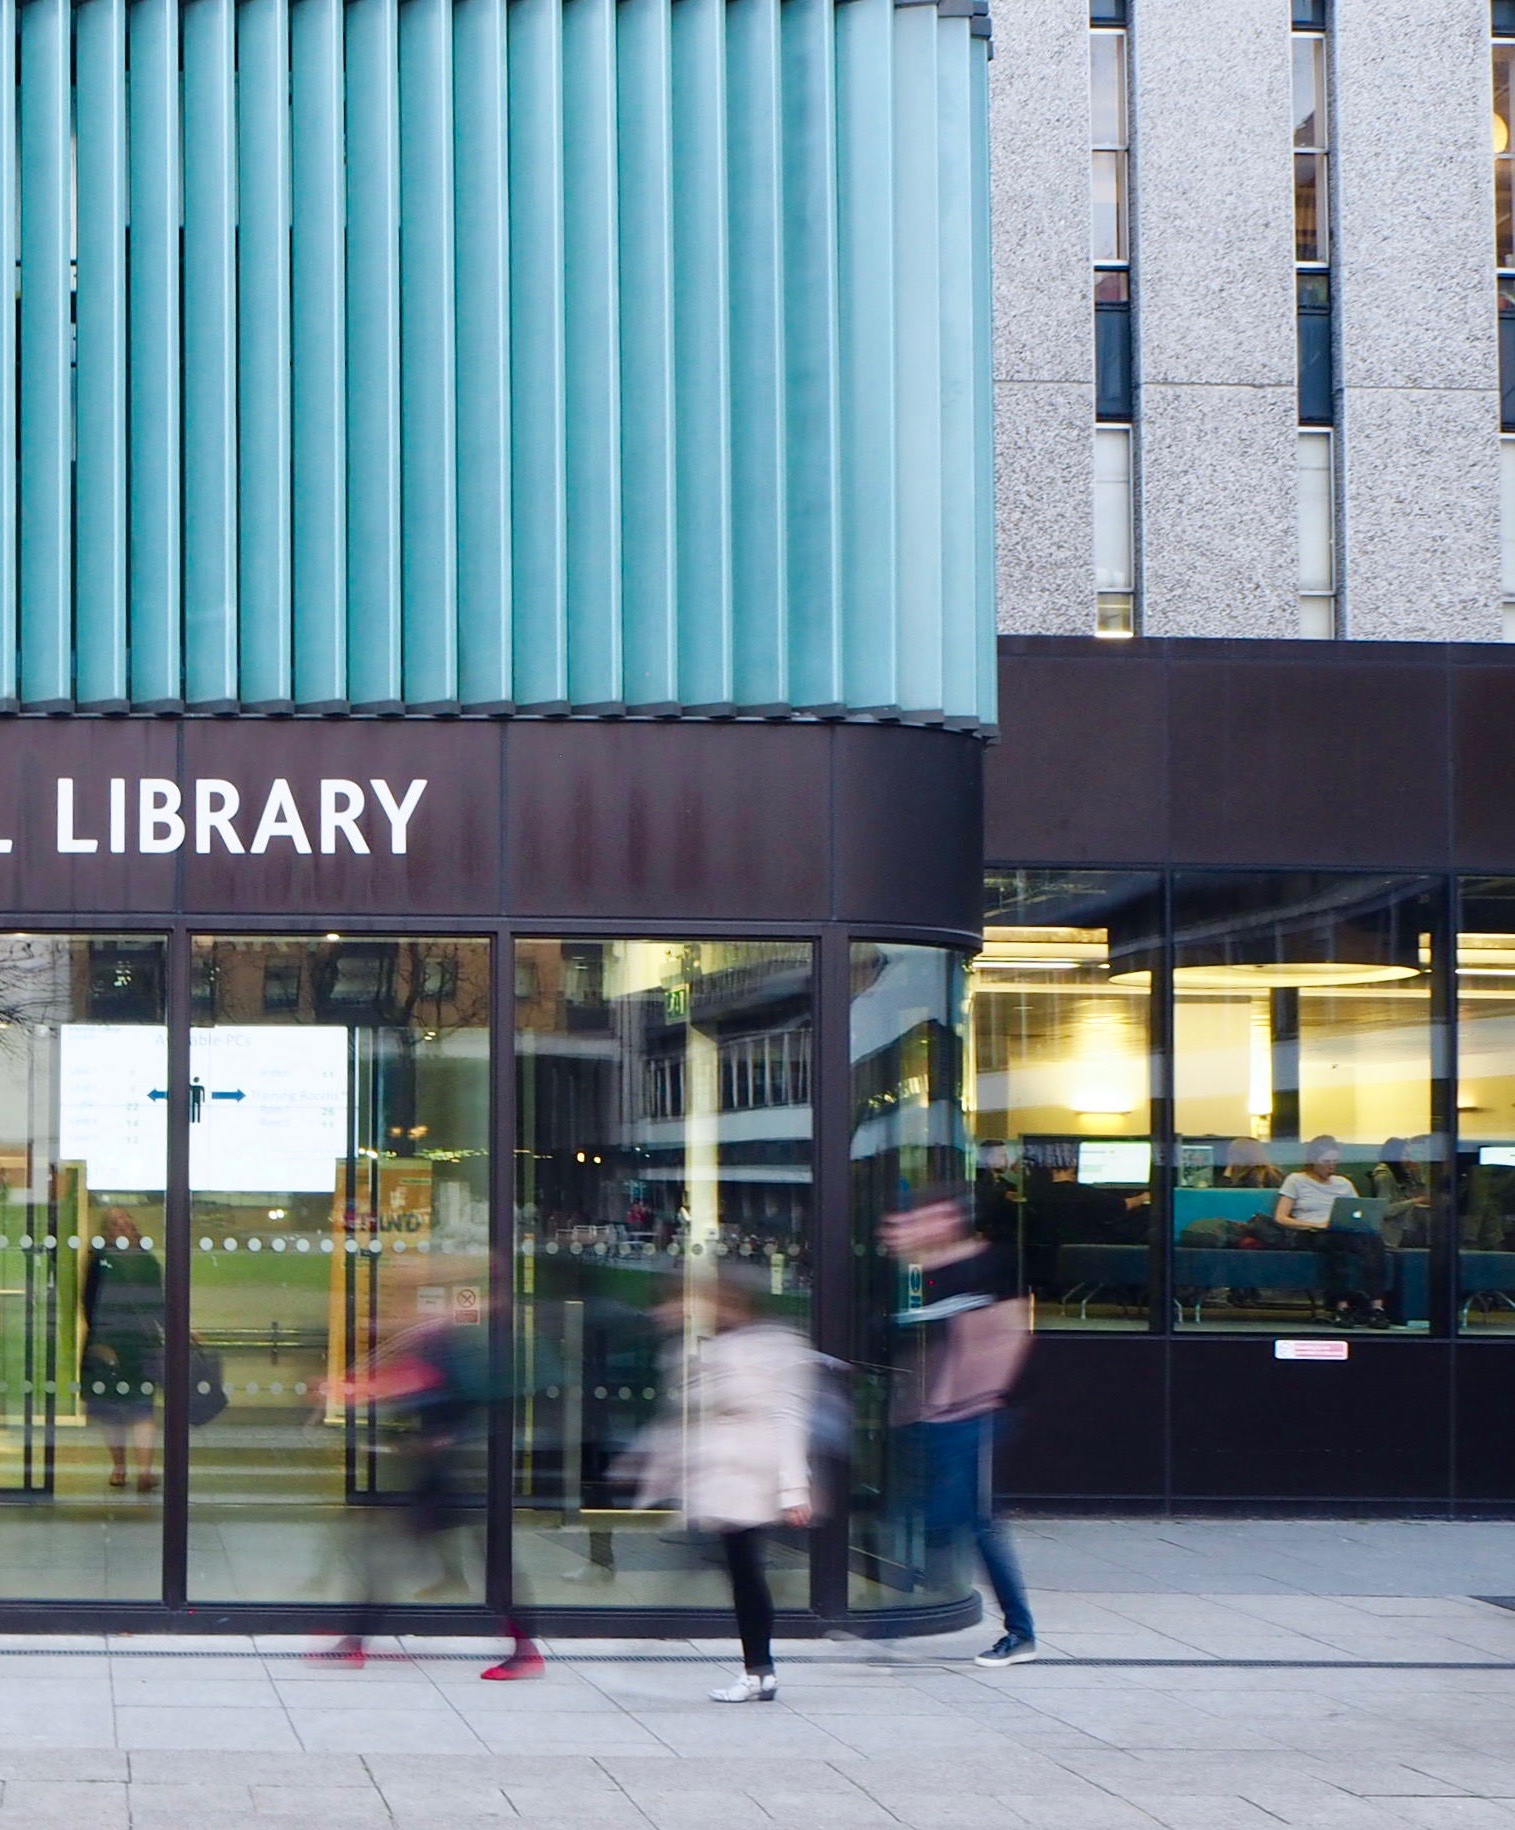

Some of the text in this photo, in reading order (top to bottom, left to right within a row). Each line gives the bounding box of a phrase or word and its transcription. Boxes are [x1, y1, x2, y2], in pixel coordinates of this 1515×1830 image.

[57, 778, 427, 854] LIBRARY
[226, 1033, 252, 1047] PCs
[250, 1089, 340, 1103] Training Rooms
